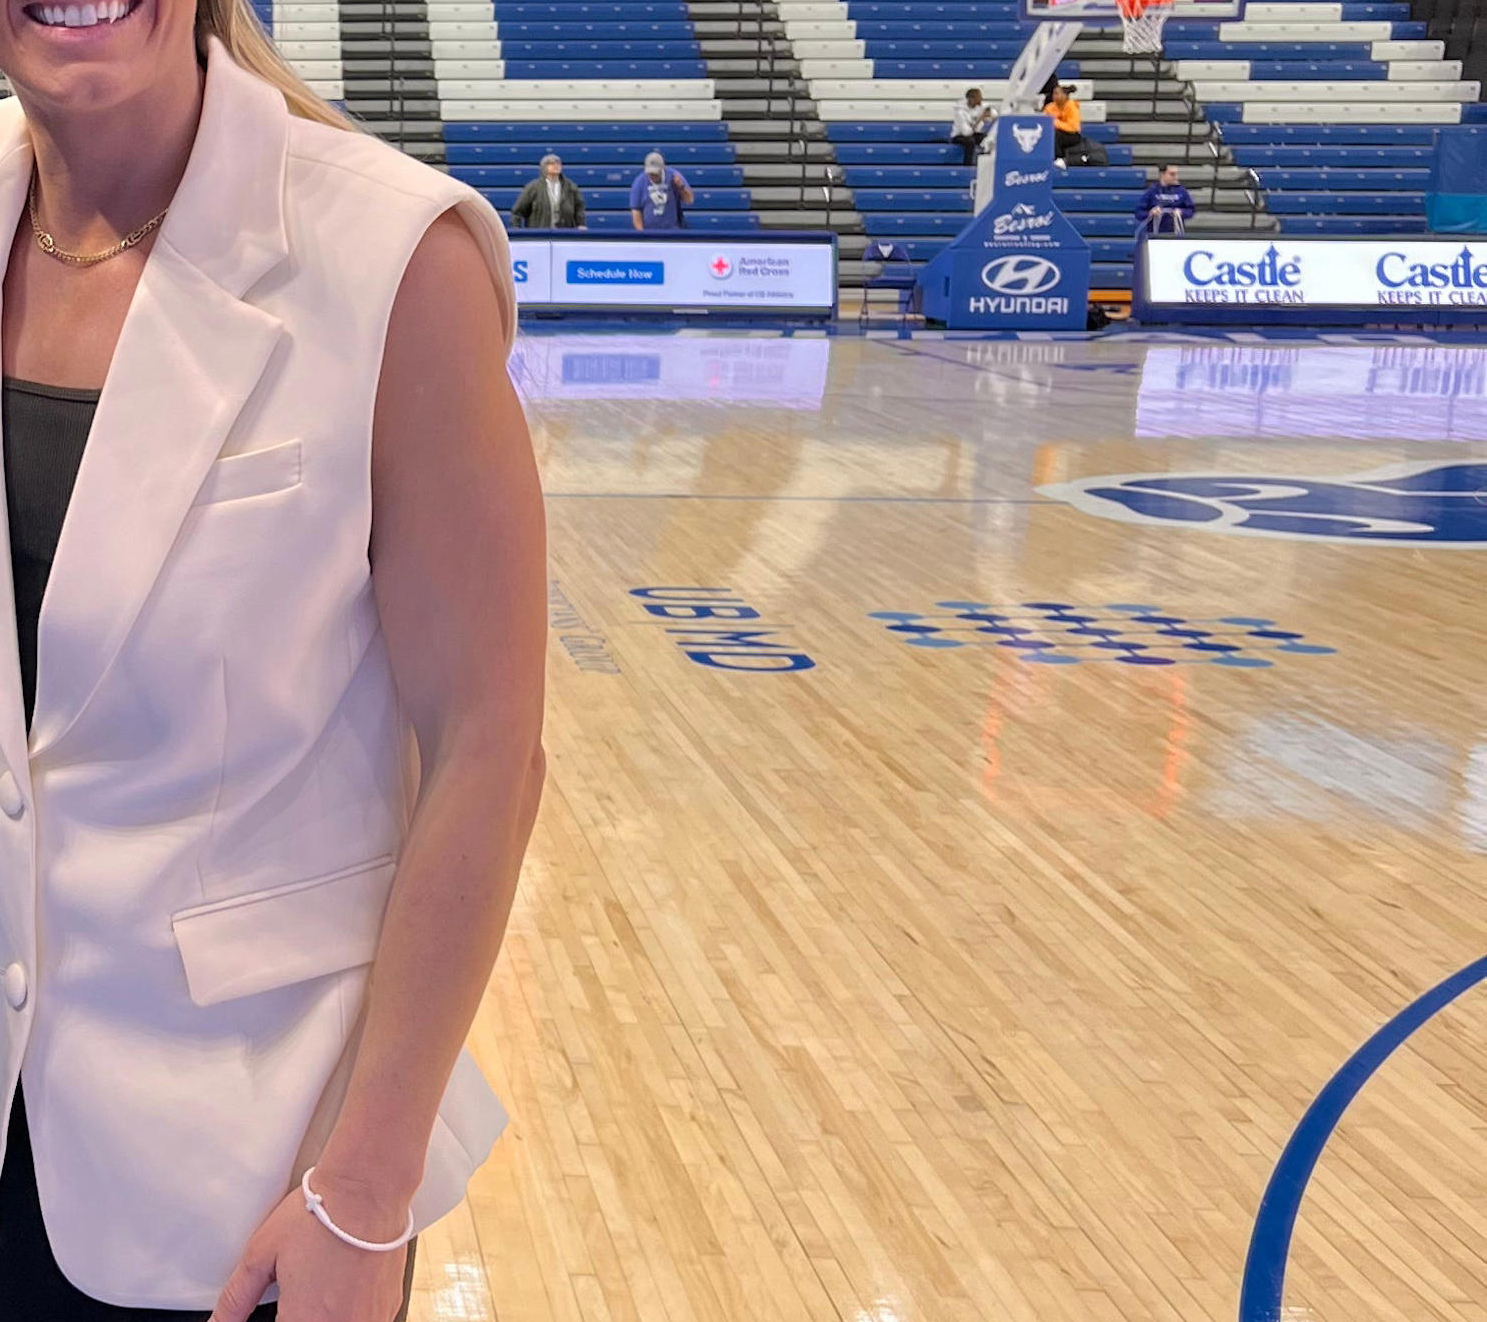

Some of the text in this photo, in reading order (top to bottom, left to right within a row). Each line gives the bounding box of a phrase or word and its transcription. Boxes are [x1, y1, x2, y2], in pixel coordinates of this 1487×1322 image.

[738, 257, 789, 266] American
[1183, 242, 1302, 288] Castle
[1376, 244, 1487, 289] Castle
[577, 265, 653, 280] Schedule Now
[738, 267, 789, 277] Red Cross
[1185, 289, 1306, 303] KEEPS IT CLEAN
[1377, 290, 1487, 305] KEEPS IT CLEA
[969, 296, 1069, 315] HYUNDAI
